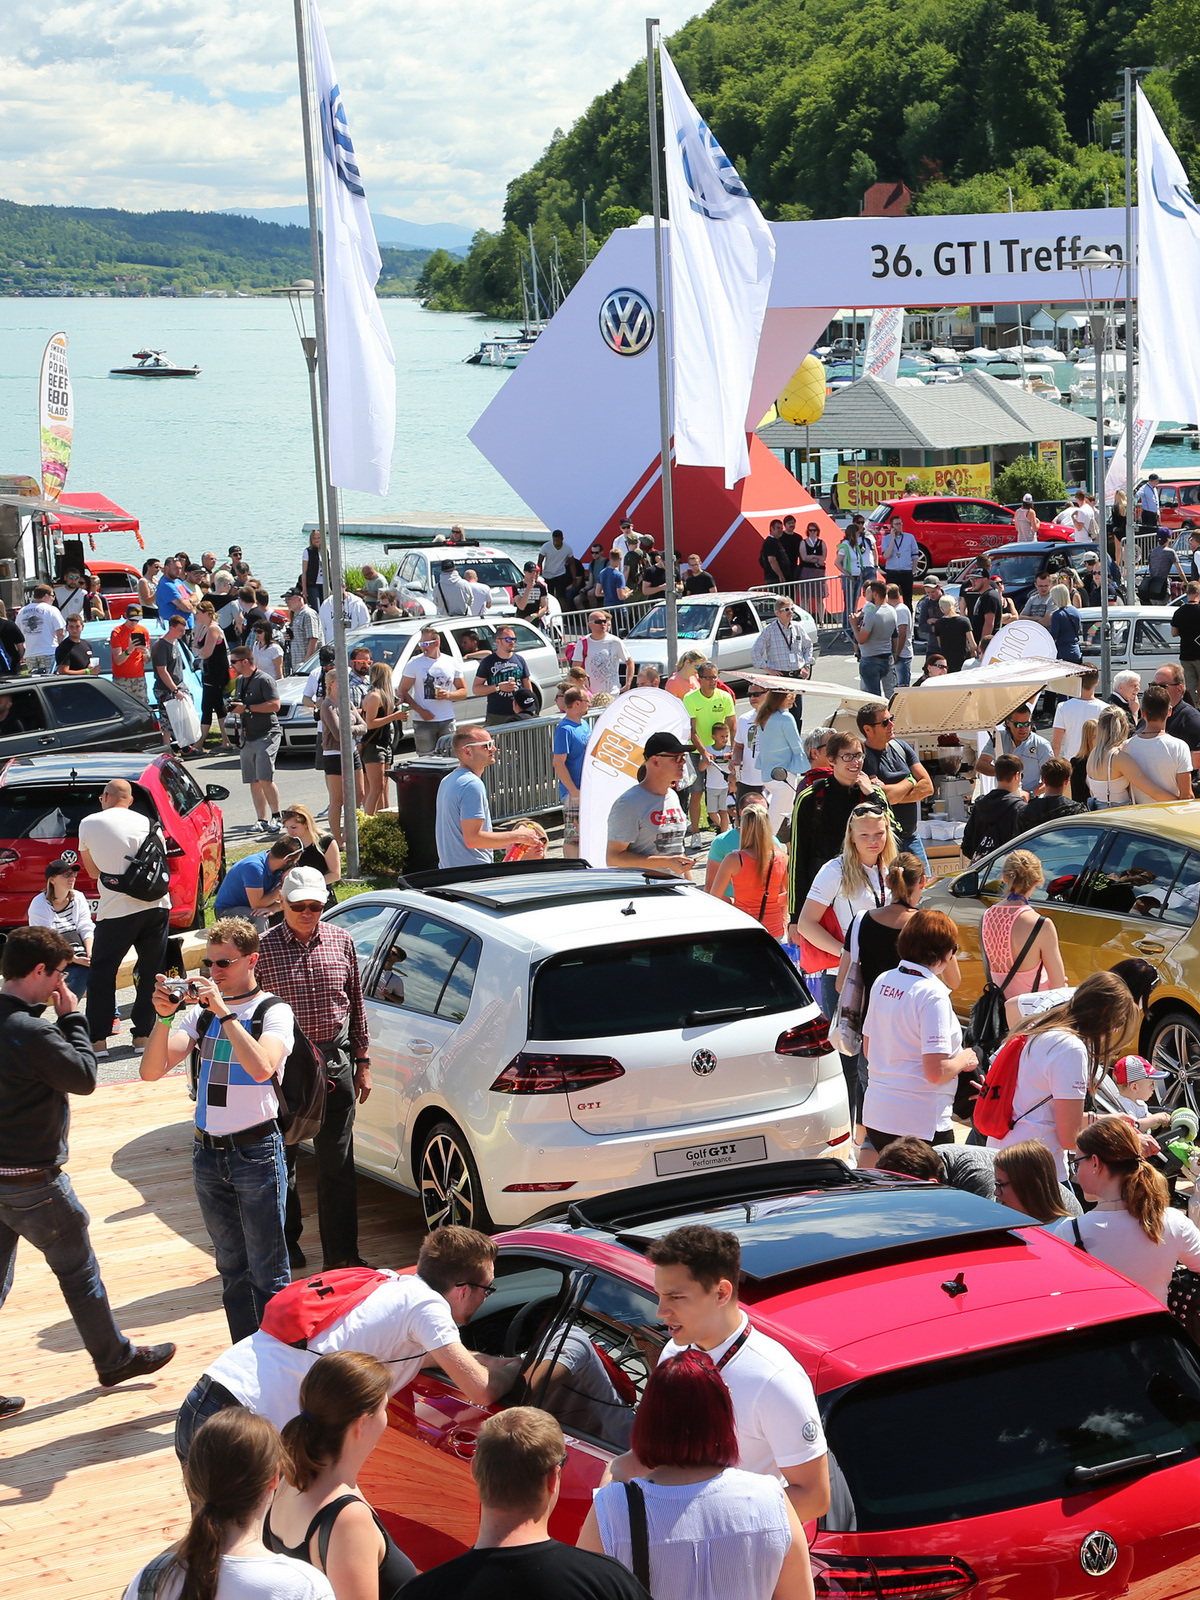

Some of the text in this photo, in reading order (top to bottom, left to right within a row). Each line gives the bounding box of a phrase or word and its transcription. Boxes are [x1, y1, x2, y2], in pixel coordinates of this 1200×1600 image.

[871, 243, 922, 278] 36.
[934, 240, 991, 276] GTI
[847, 470, 902, 488] BOOT-
[650, 808, 684, 825] GTI
[879, 984, 905, 1000] TEAM
[980, 1083, 1002, 1099] GI
[577, 1101, 602, 1110] GTI
[685, 1144, 737, 1161] Golf GTI
[692, 1156, 732, 1167] Performance
